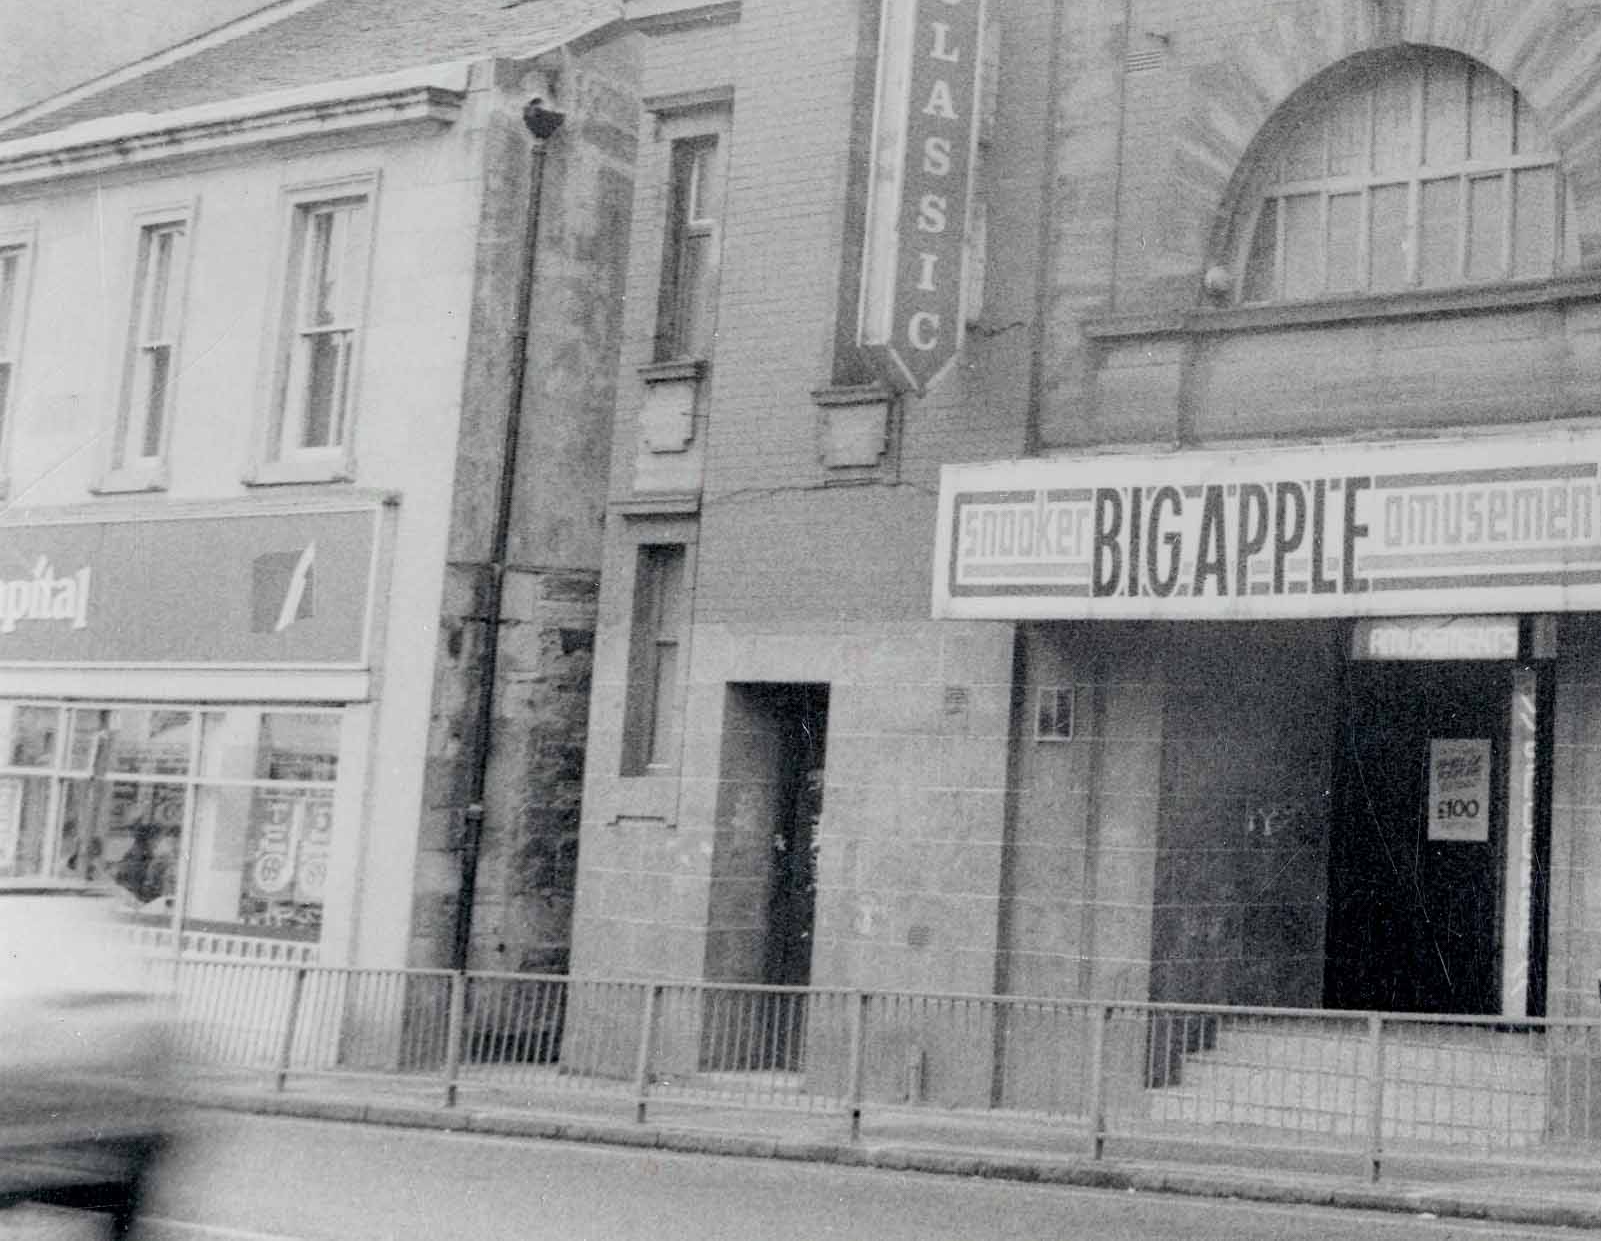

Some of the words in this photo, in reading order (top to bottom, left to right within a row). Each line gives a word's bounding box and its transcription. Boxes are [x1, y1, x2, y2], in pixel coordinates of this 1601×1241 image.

[962, 495, 1091, 559] snooker
[1092, 484, 1184, 598] BIG
[1193, 475, 1372, 597] APPLE
[1437, 798, 1481, 820] £100
